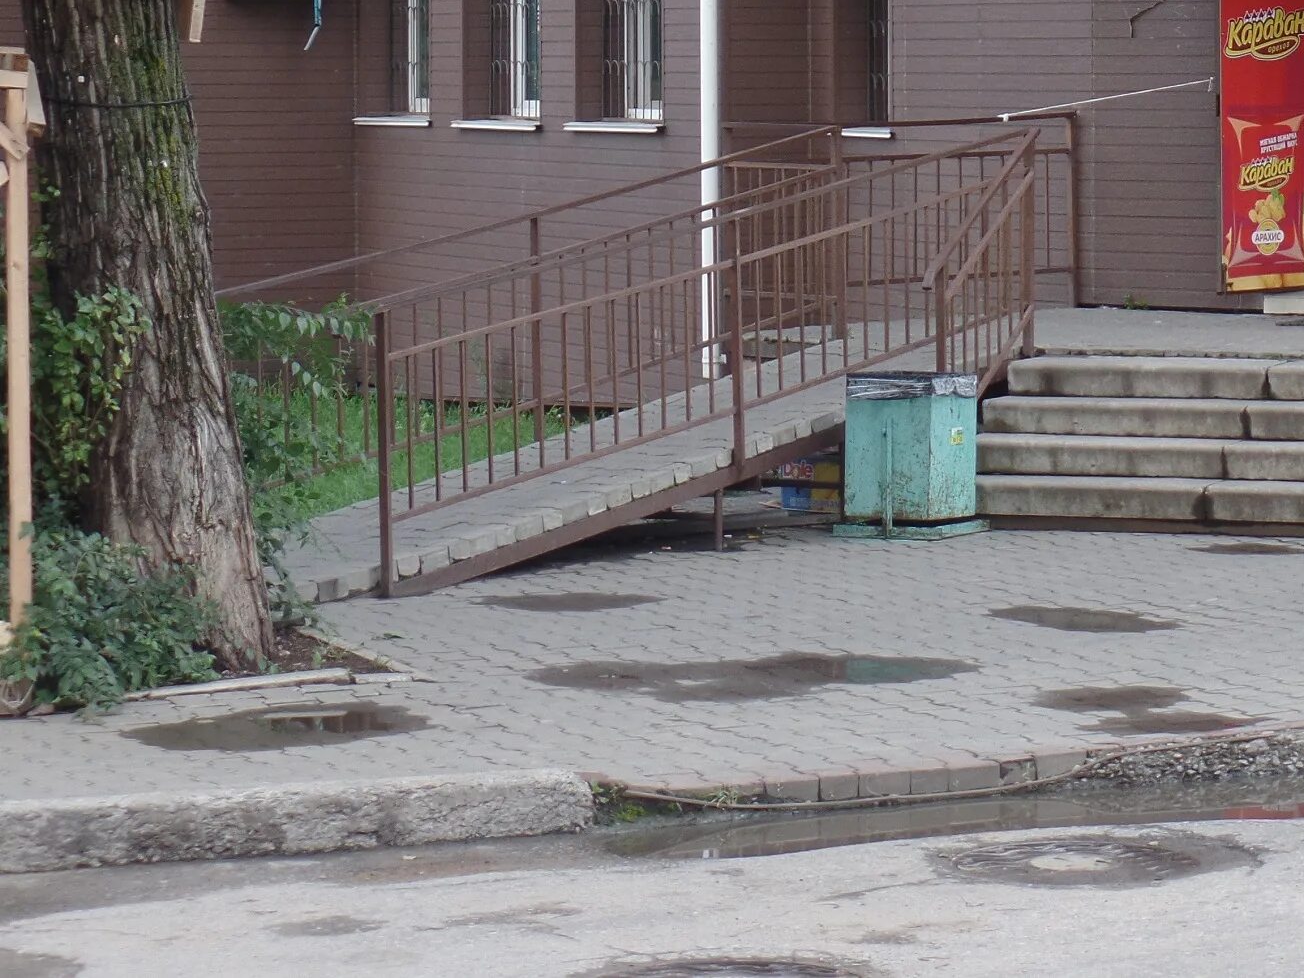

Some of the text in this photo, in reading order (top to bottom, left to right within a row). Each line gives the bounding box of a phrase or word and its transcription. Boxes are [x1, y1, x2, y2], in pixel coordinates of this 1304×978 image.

[1242, 157, 1294, 184] Караван
[1254, 232, 1282, 242] АРАХИС
[783, 460, 814, 479] Dole
